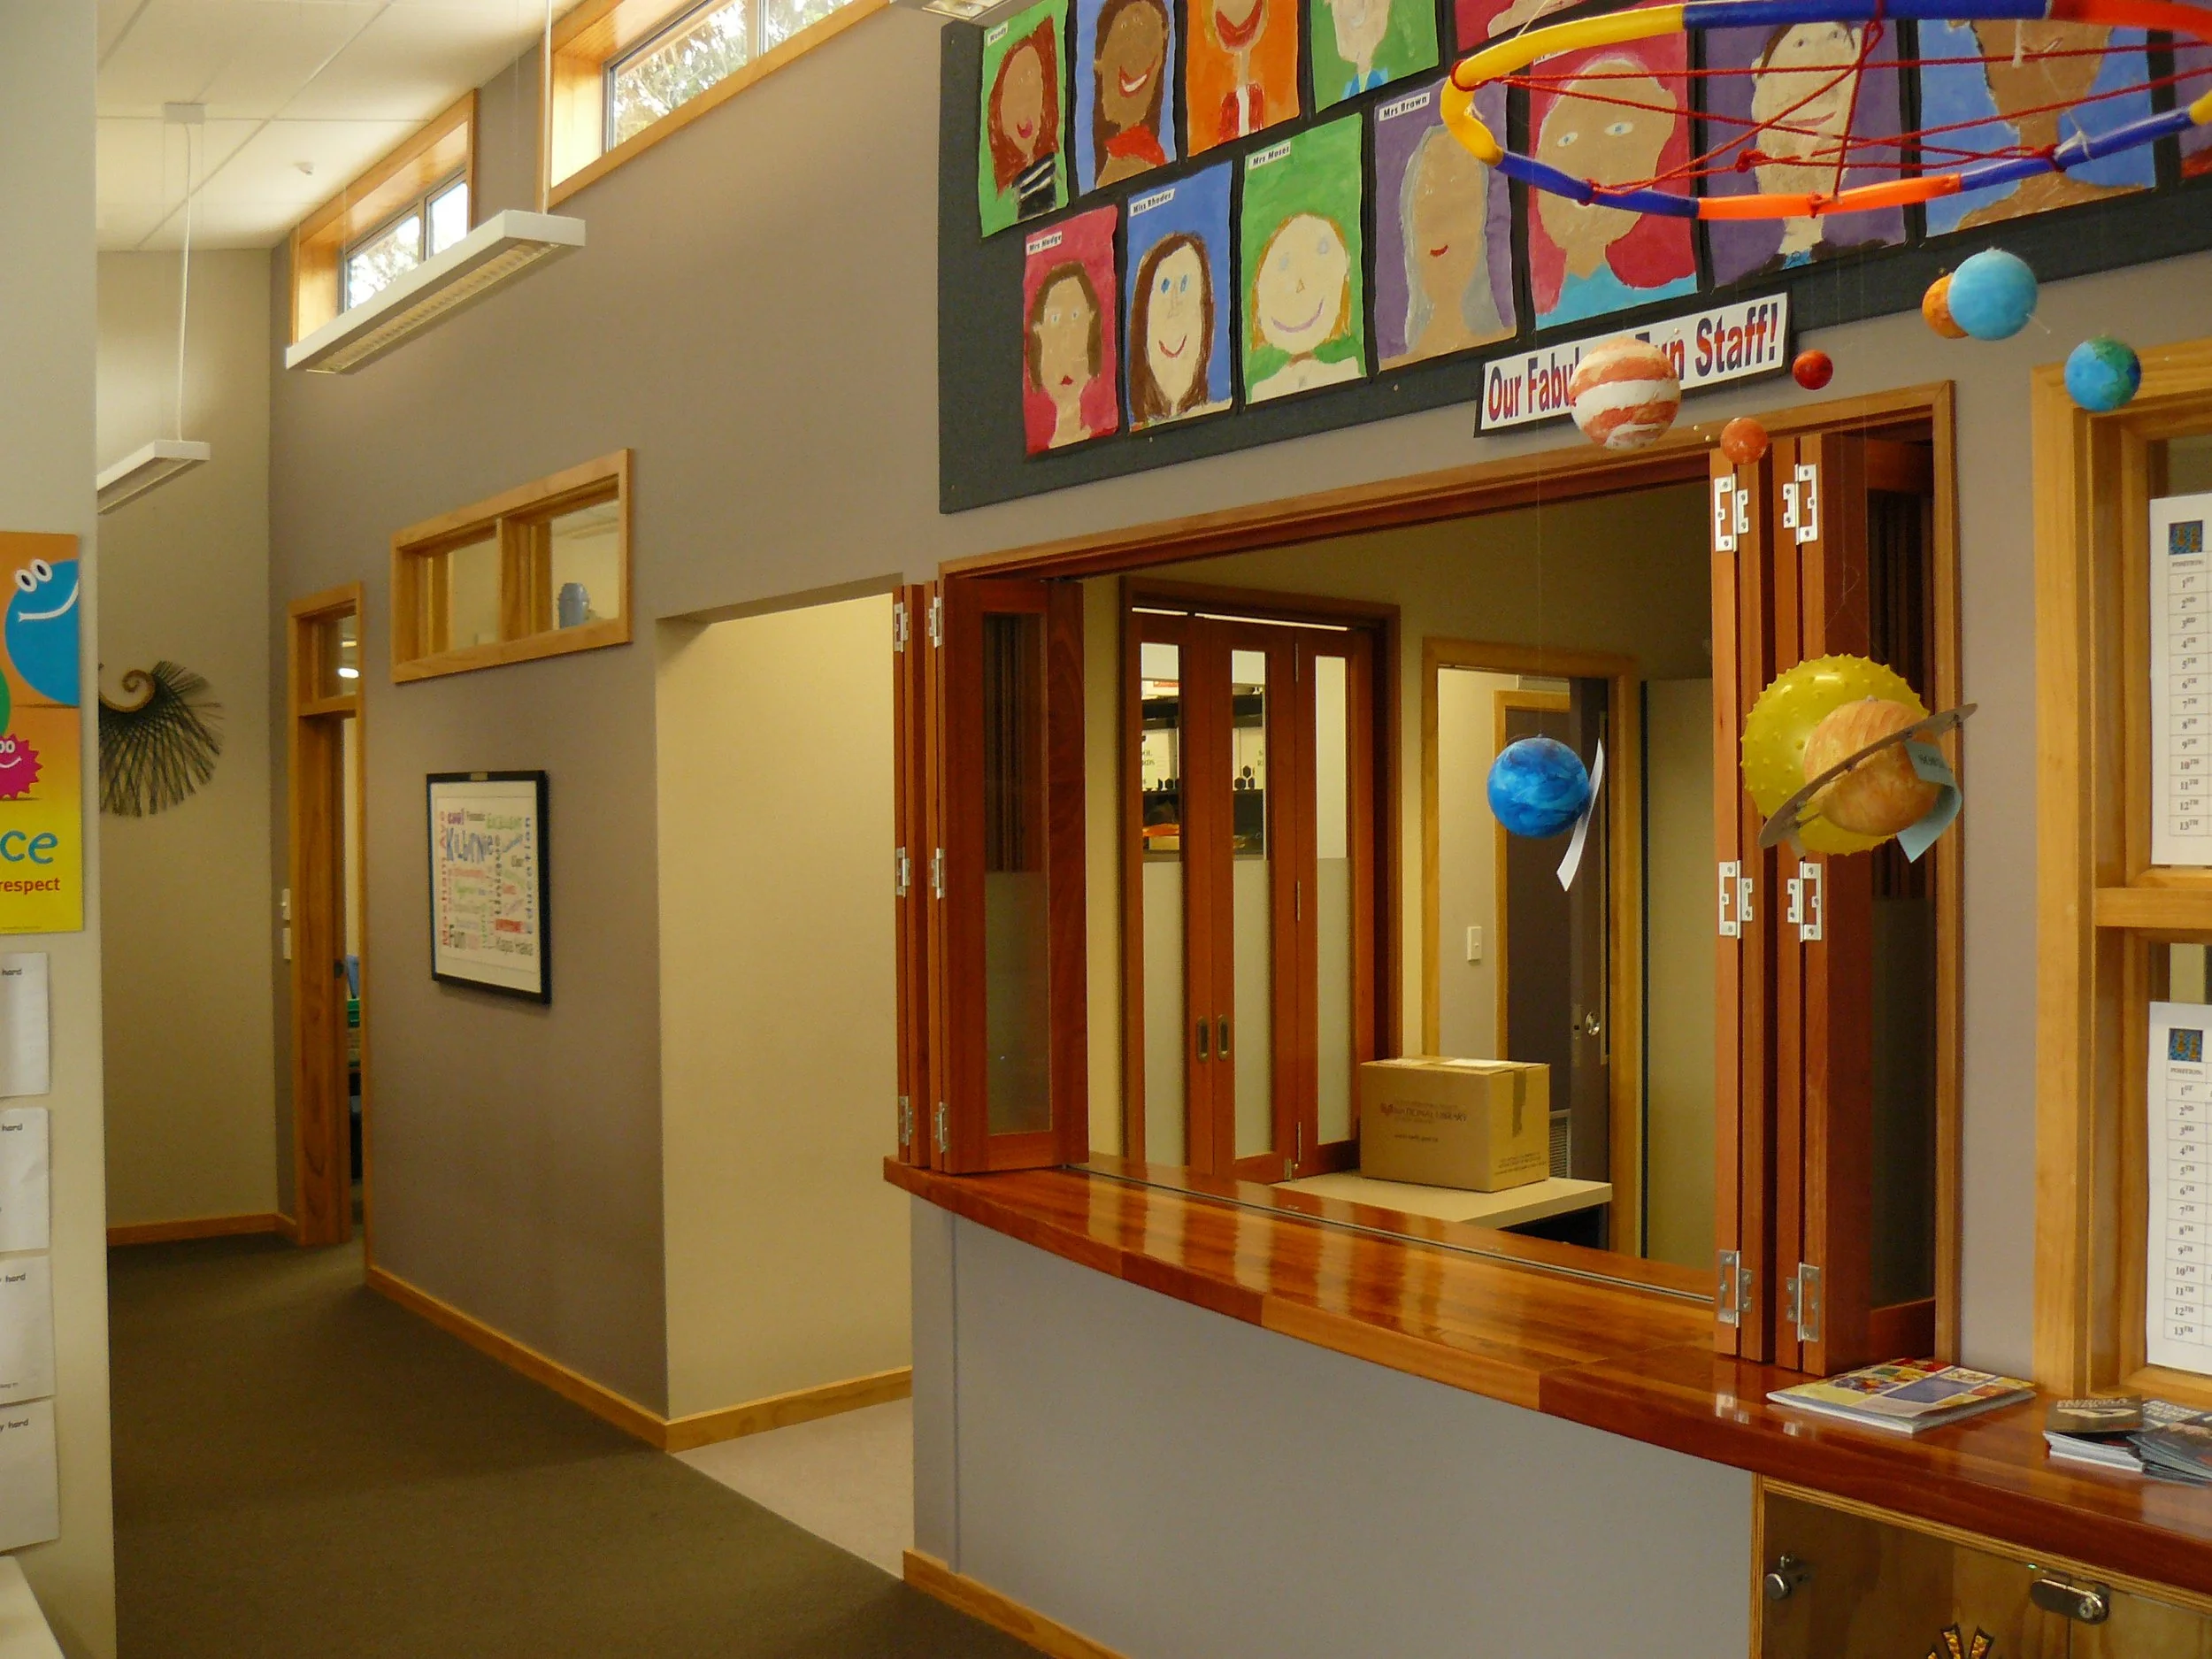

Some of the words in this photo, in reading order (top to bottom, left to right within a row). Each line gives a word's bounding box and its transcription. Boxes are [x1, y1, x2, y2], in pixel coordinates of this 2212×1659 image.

[1384, 107, 1398, 119] Mrs
[1401, 96, 1427, 112] Brown
[1252, 156, 1265, 166] Mrs
[1488, 366, 1522, 421] Our
[1694, 302, 1778, 378] Staff!
